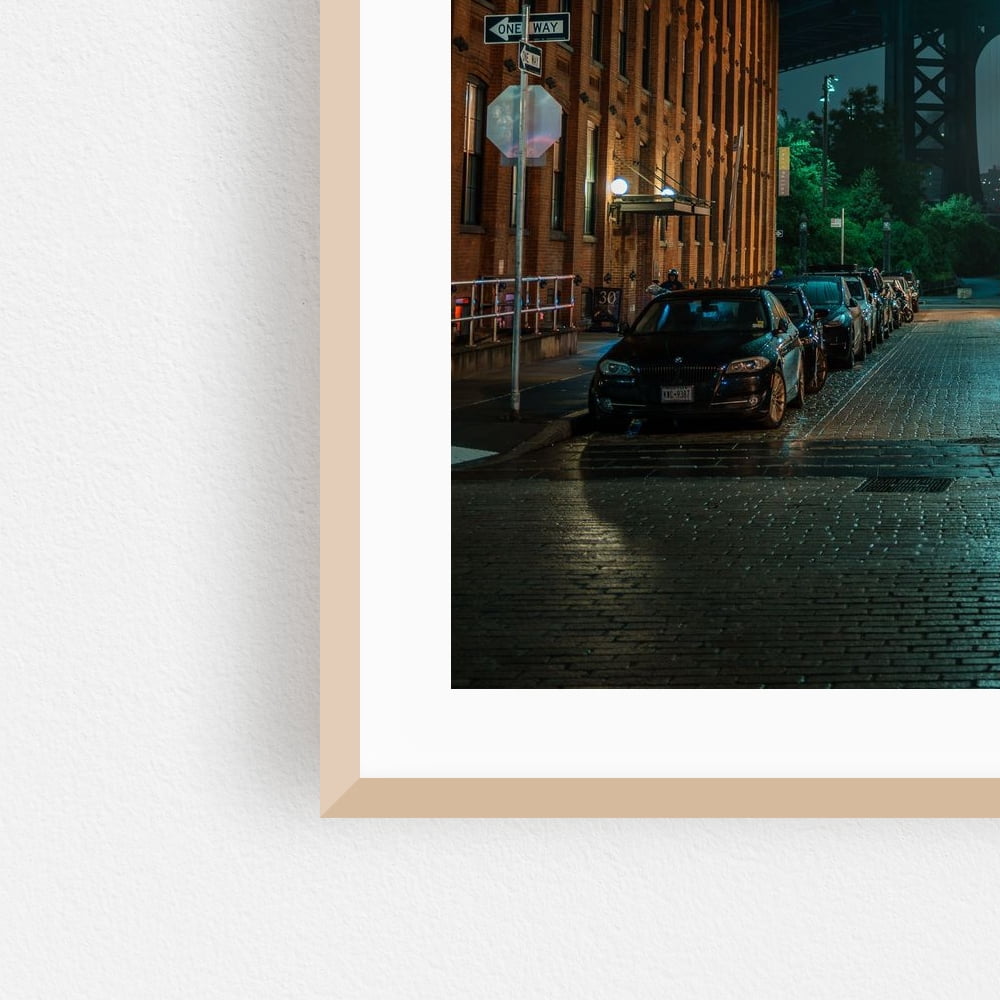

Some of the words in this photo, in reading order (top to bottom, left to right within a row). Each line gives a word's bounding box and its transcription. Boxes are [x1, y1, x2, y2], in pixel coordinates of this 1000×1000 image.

[498, 23, 522, 35] ONE
[533, 22, 558, 33] WAY
[599, 290, 616, 304] 30
